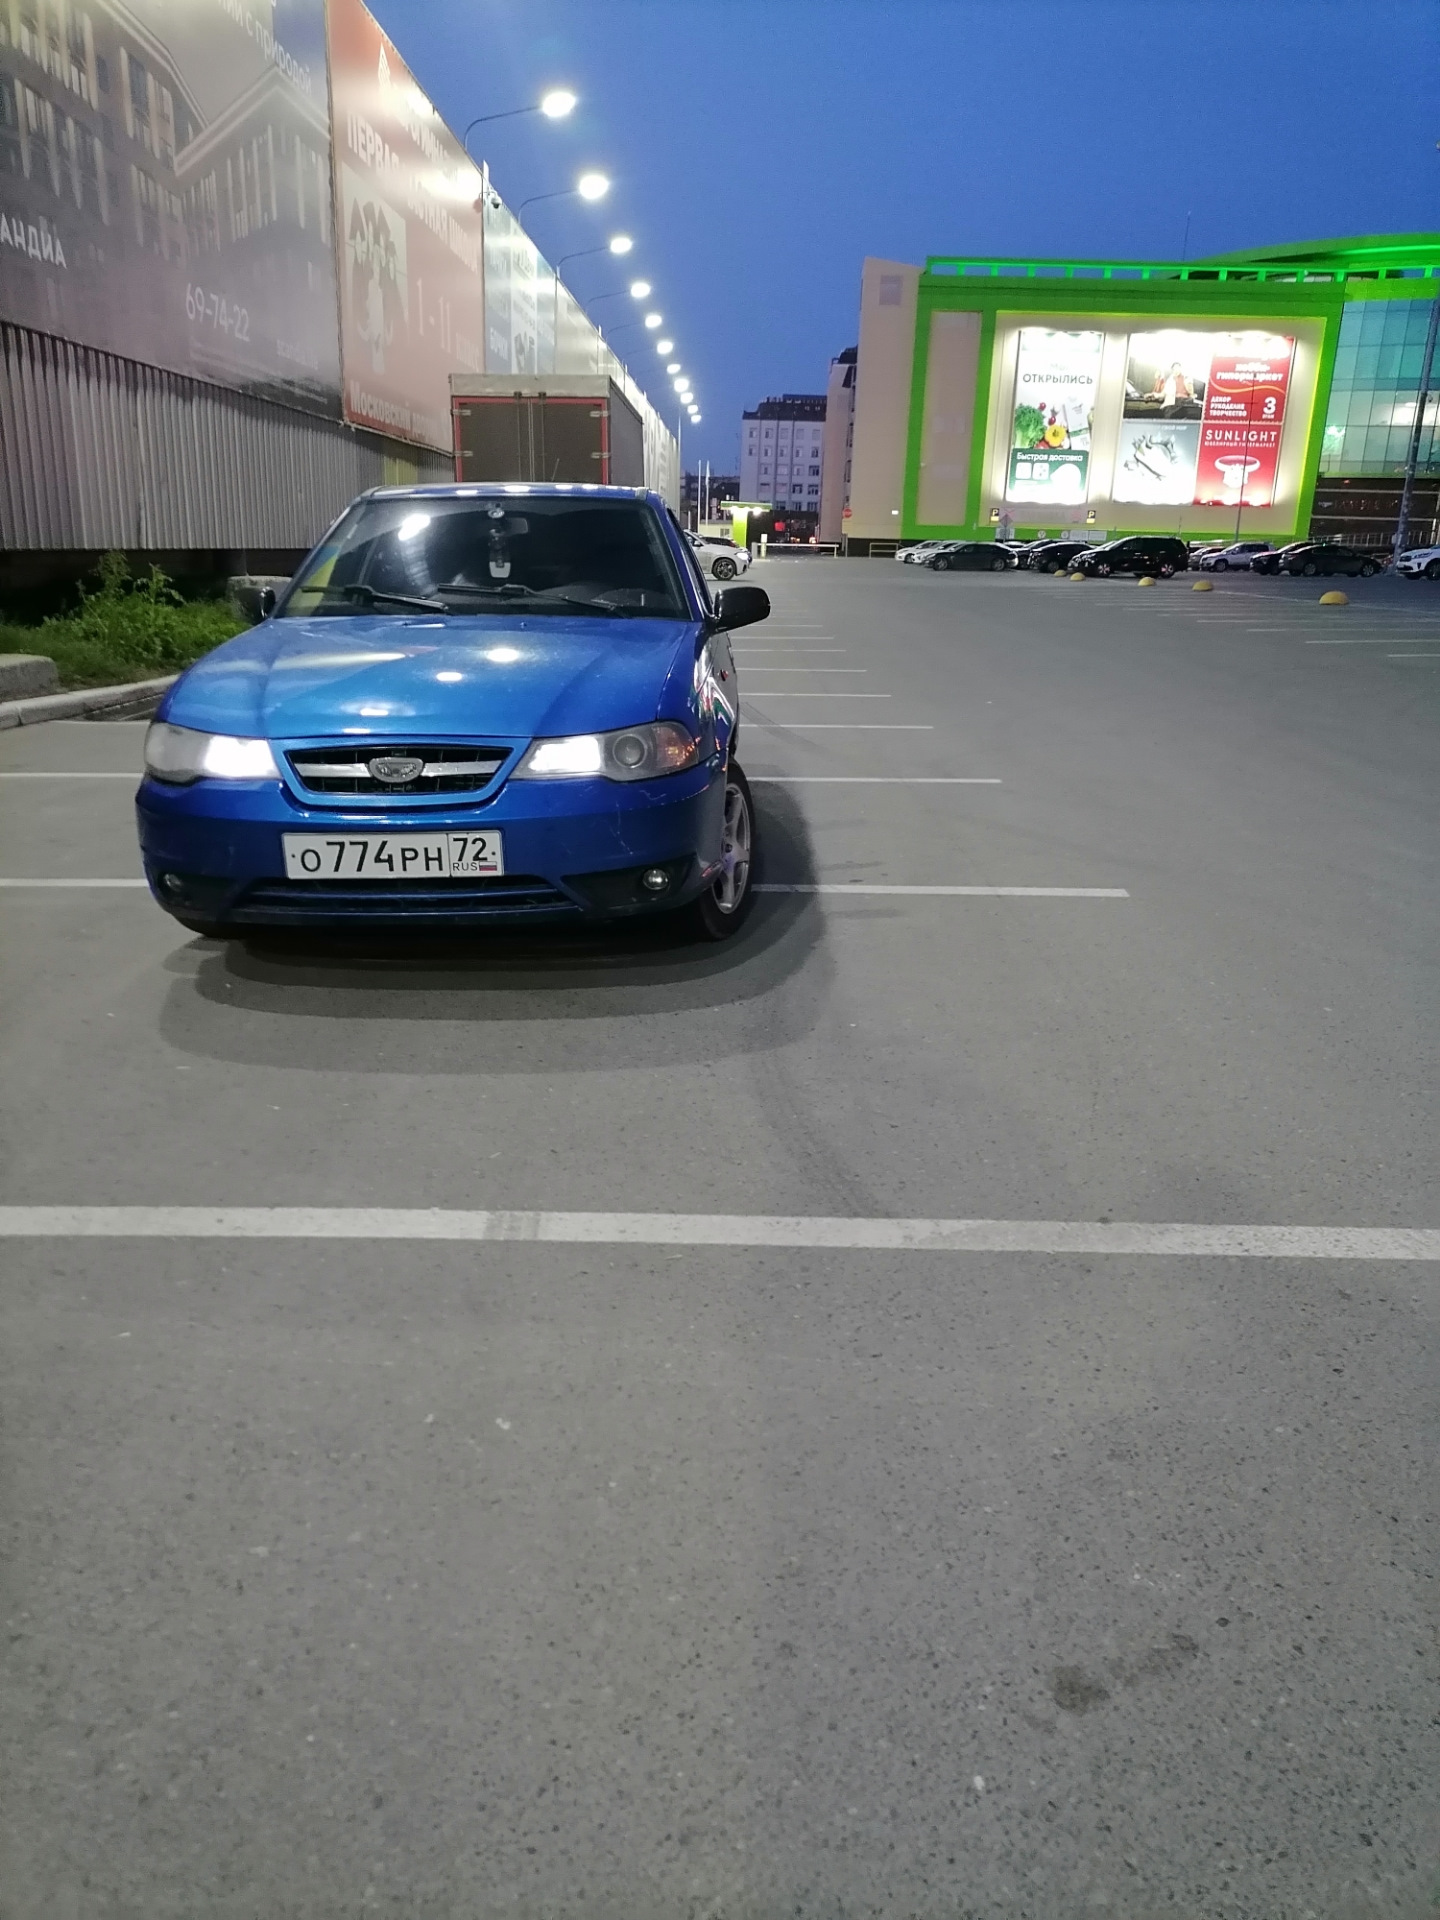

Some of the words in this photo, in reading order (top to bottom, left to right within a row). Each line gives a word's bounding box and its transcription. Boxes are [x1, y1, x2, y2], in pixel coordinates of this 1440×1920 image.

[255, 20, 311, 98] природой
[186, 282, 250, 342] 69-74-22
[1022, 373, 1093, 385] ОТКРЫЛИСЬ
[1264, 396, 1276, 413] 3
[1205, 429, 1277, 441] SUNLIGHT
[452, 837, 488, 862] 72
[452, 862, 478, 871] RUS
